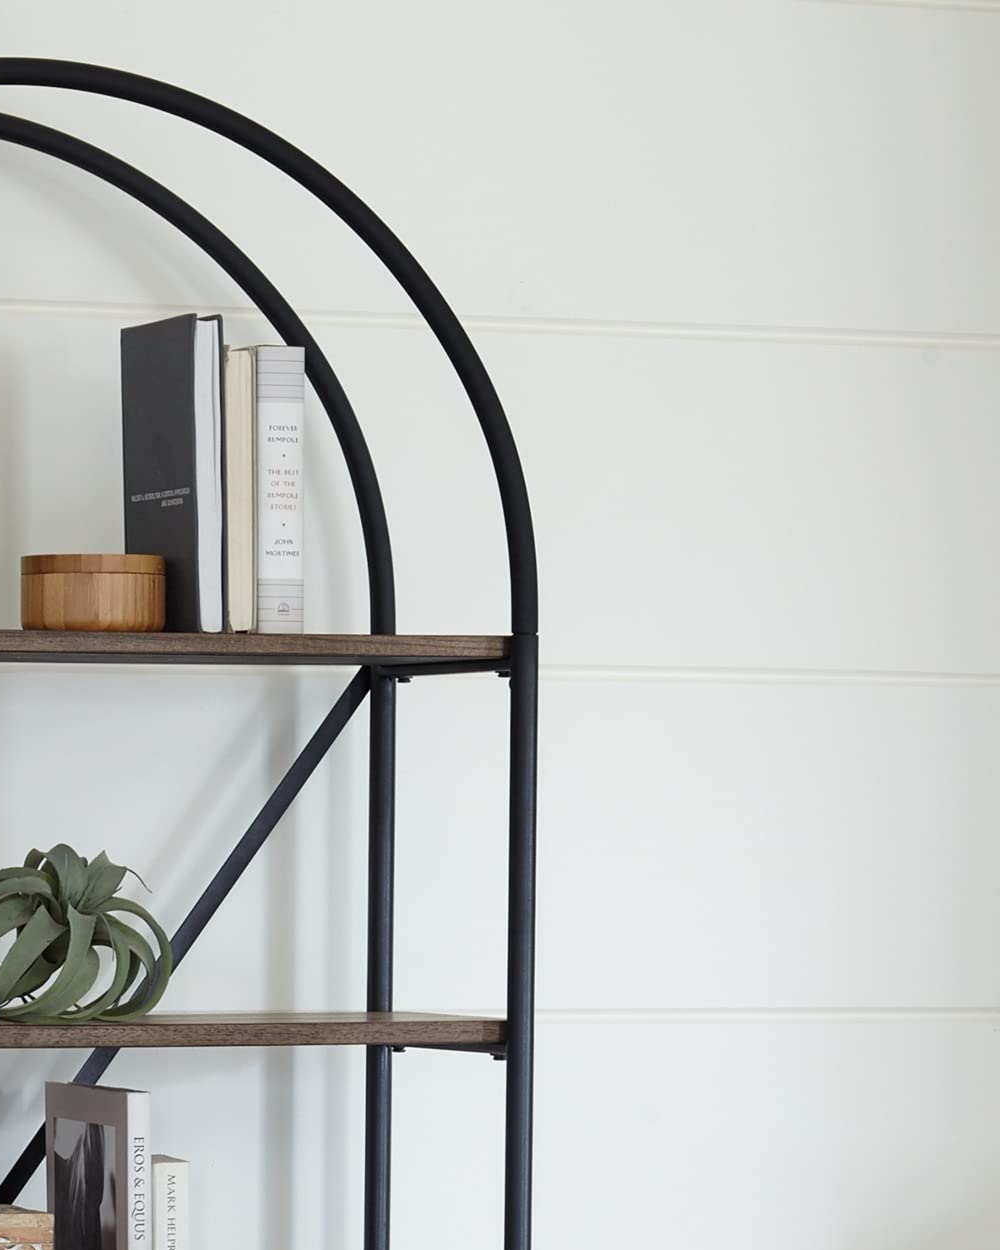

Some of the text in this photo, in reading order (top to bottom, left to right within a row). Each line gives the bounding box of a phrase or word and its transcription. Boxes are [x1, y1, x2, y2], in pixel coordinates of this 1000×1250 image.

[131, 1137, 146, 1241] EROS & EQUUS
[167, 1174, 177, 1213] MARK
